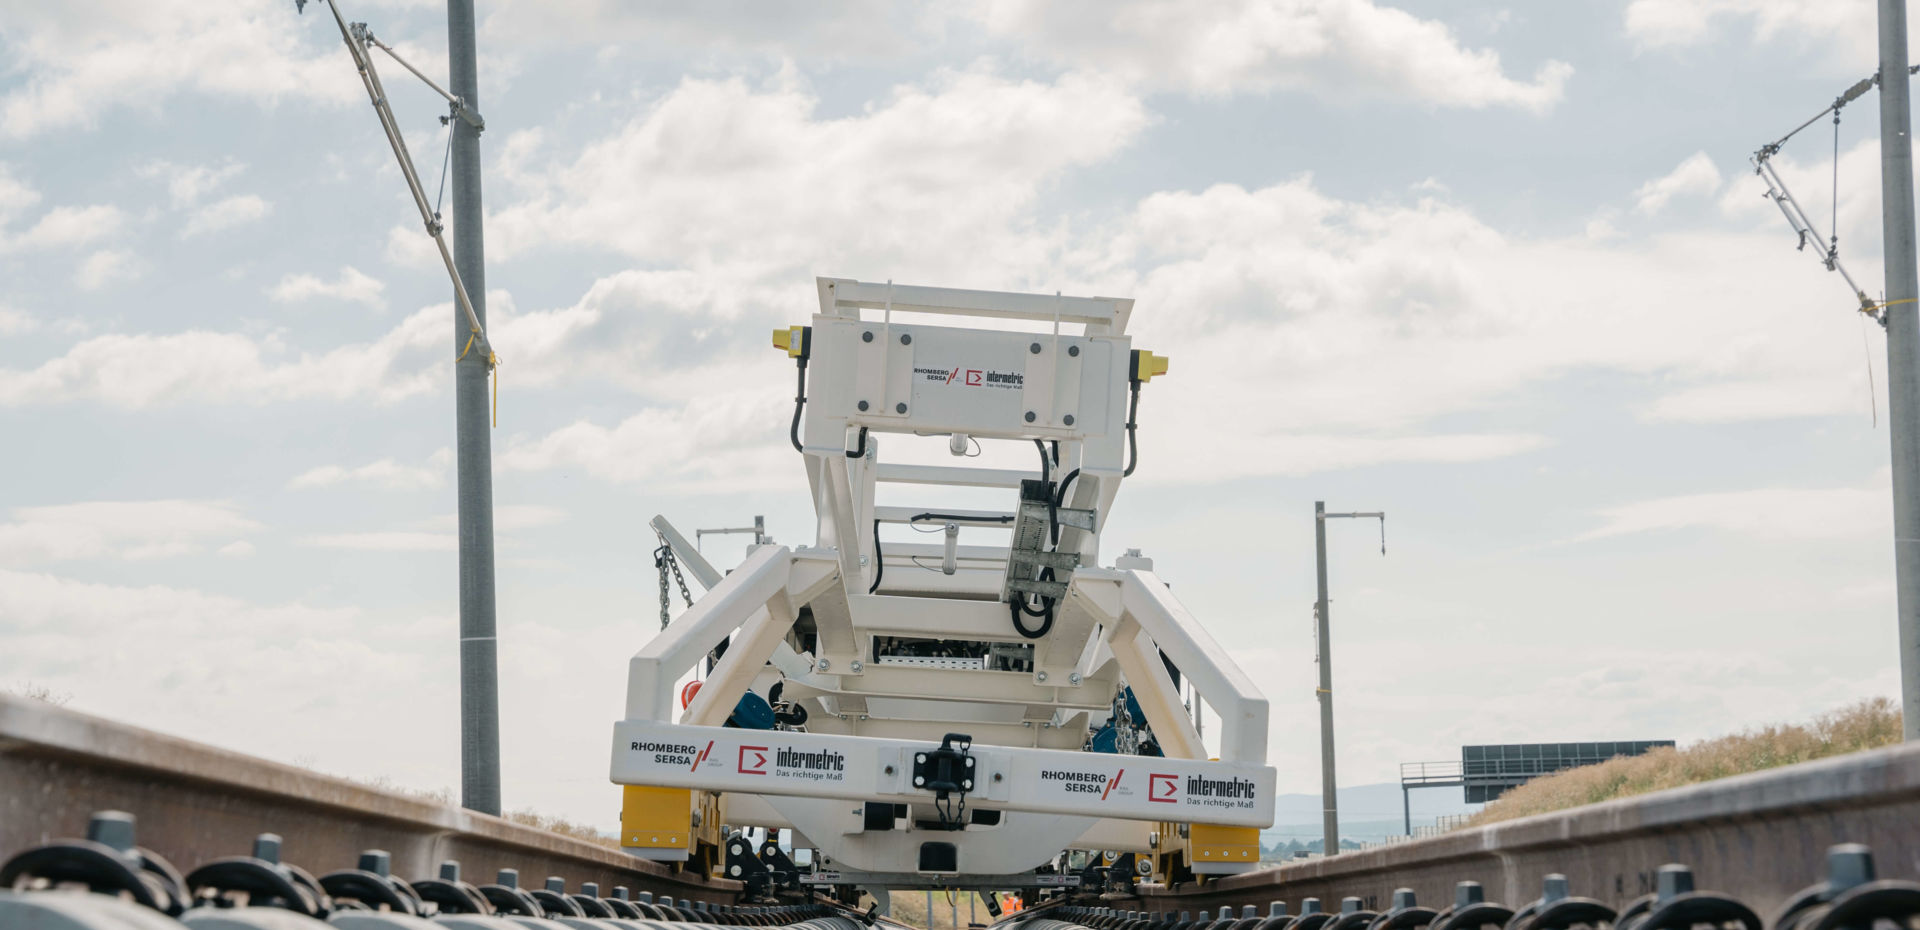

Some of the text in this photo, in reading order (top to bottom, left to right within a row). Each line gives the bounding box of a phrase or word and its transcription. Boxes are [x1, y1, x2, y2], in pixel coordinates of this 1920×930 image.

[987, 370, 1024, 384] intermetric
[631, 742, 696, 754] RHOMBERG
[654, 754, 691, 765] SERSA
[776, 747, 844, 771] intermetric
[776, 769, 790, 777] Das
[793, 770, 824, 780] richtige
[1041, 771, 1106, 783] RHOMBERG
[1065, 783, 1102, 794] SERSA
[1187, 774, 1255, 799] intermetric
[1203, 798, 1235, 808] richtige
